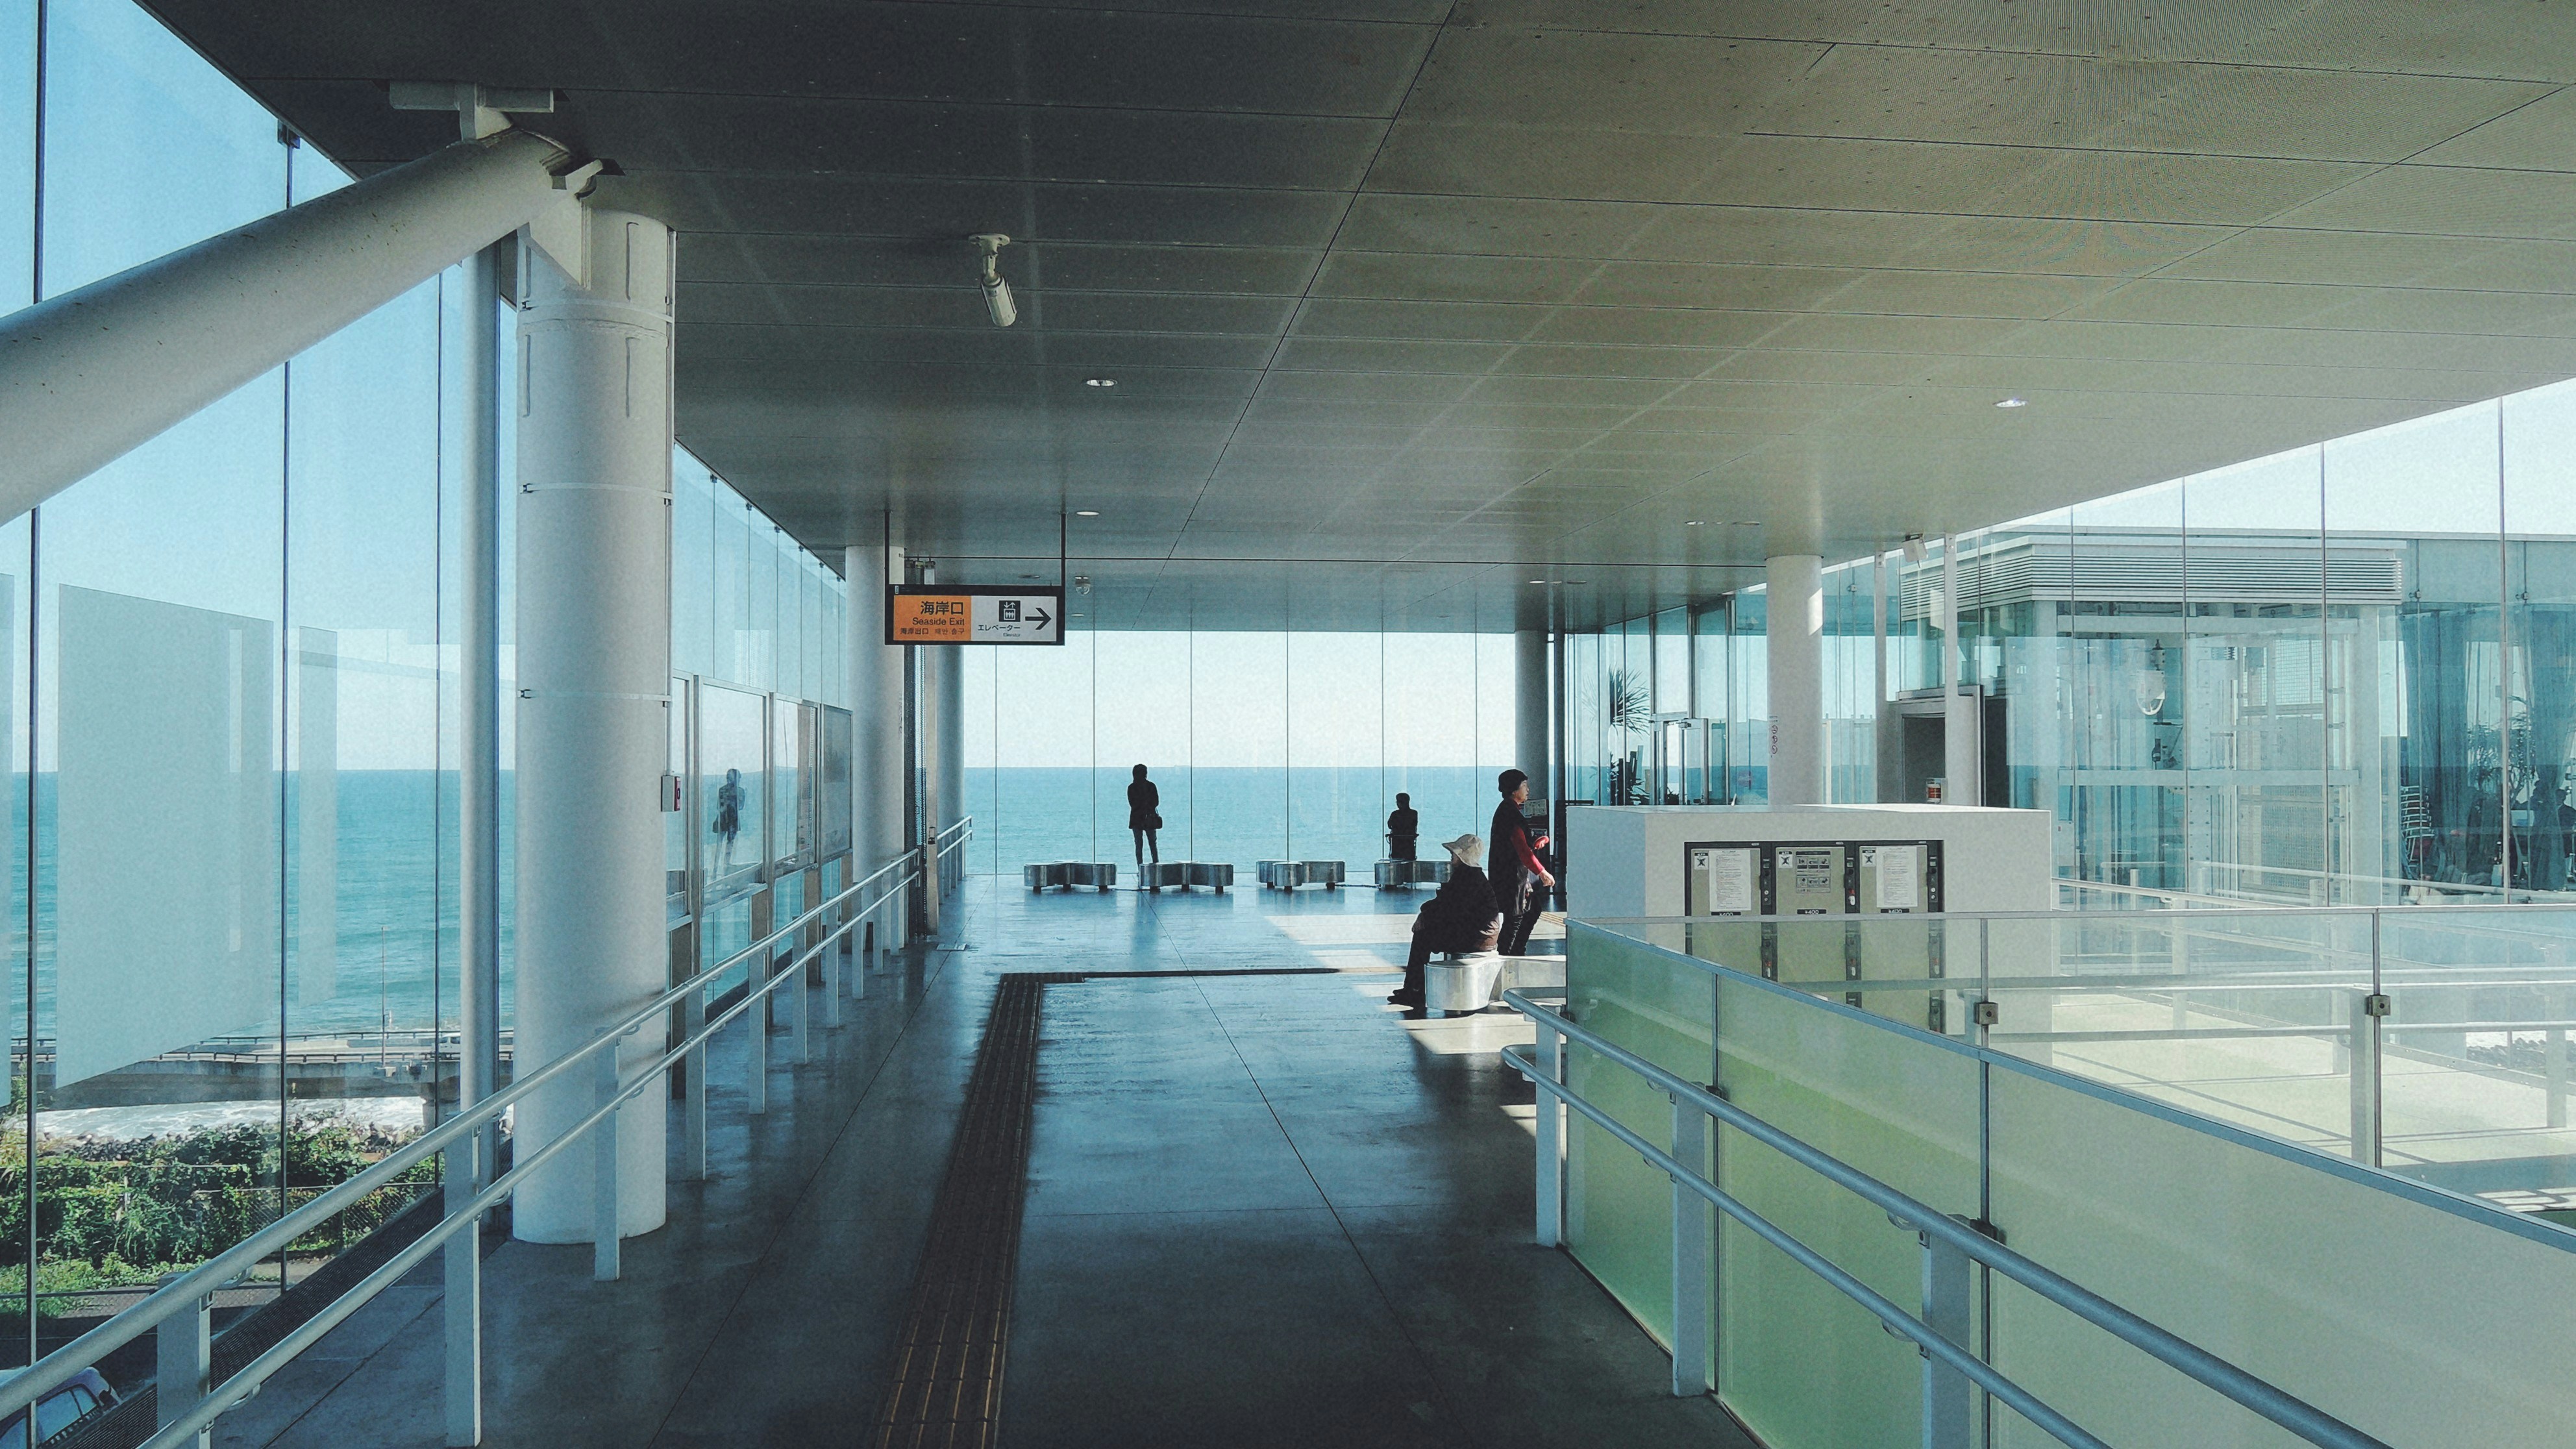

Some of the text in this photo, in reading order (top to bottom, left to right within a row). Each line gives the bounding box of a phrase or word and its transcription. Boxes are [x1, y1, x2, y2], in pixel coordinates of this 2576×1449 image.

[921, 601, 963, 615] 海岸口
[912, 617, 947, 625] Seaside
